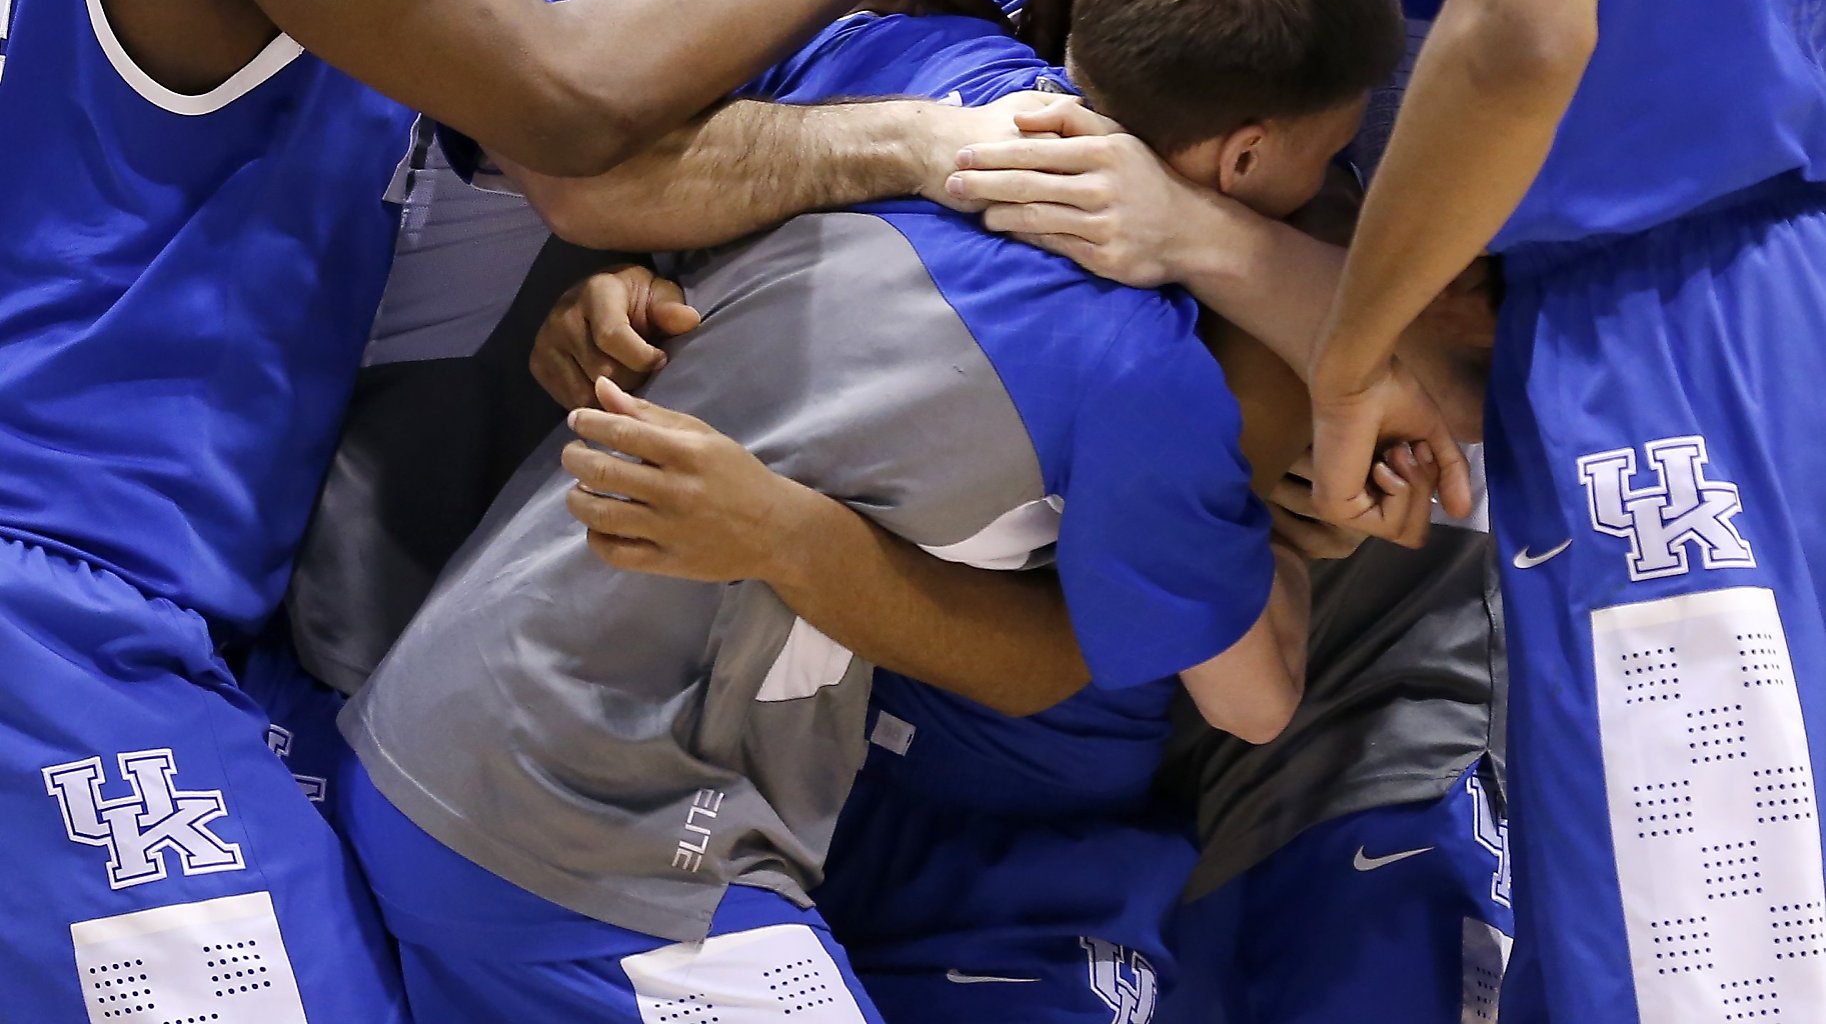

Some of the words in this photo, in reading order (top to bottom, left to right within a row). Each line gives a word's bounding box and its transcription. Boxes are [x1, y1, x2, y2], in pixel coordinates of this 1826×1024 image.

[1577, 435, 1757, 582] UK
[41, 747, 246, 890] UK
[671, 788, 724, 873] ELITE
